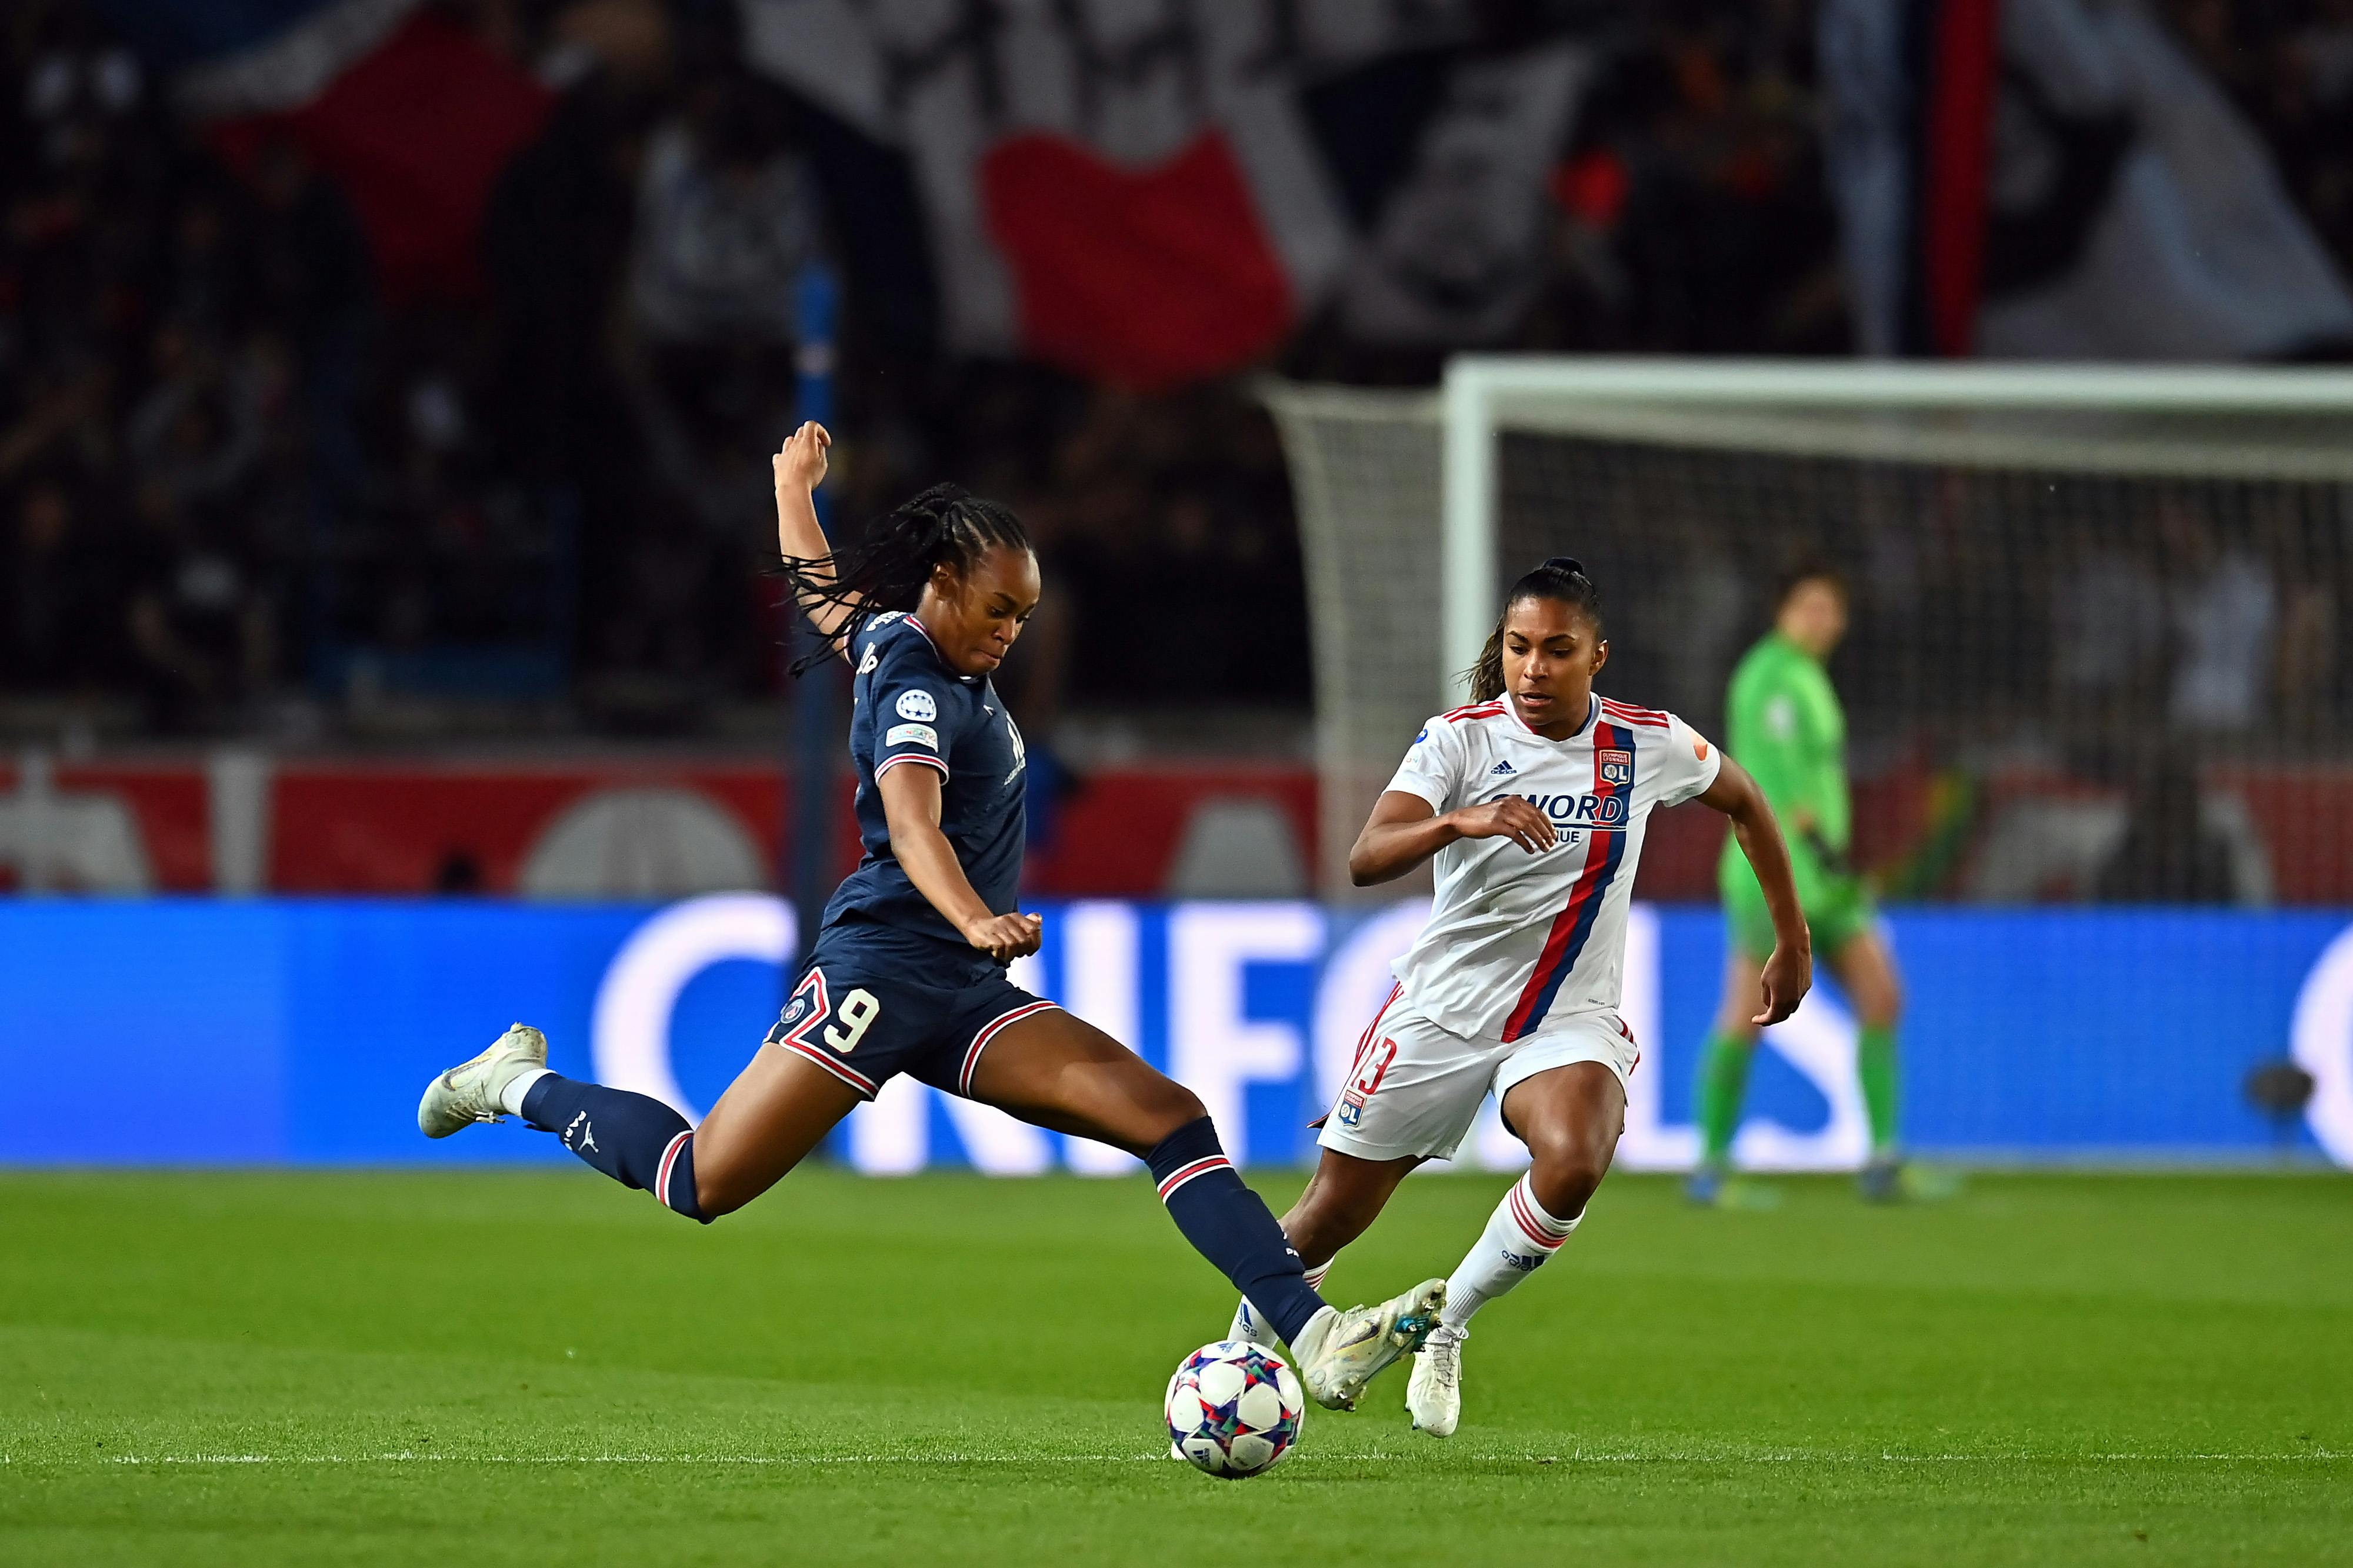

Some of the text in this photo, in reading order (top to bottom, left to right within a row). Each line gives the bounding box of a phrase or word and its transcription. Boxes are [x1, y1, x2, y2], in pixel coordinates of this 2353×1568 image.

[1491, 793, 1623, 823] ORD
[823, 988, 881, 1055] 9
[1350, 1034, 1398, 1096] 13
[1501, 1249, 1534, 1272] adid
